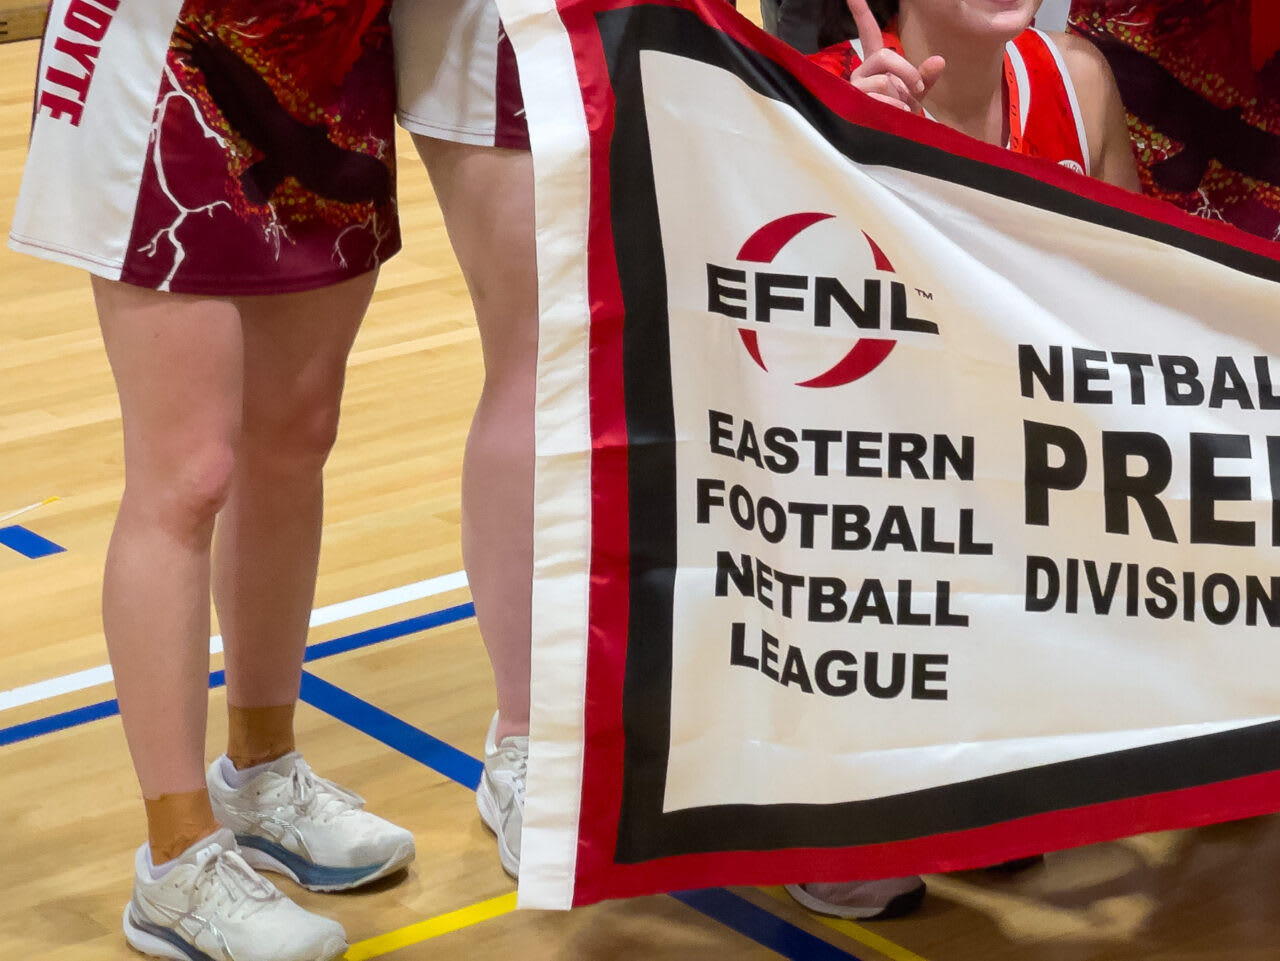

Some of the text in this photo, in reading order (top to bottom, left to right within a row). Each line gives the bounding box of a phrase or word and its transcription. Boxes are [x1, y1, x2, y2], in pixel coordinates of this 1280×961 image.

[706, 263, 939, 335] EFNL
[708, 409, 976, 481] EASTERN
[696, 478, 994, 556] FOOTBALL
[715, 551, 970, 628] NETBALL
[730, 622, 950, 701] LEAGUE
